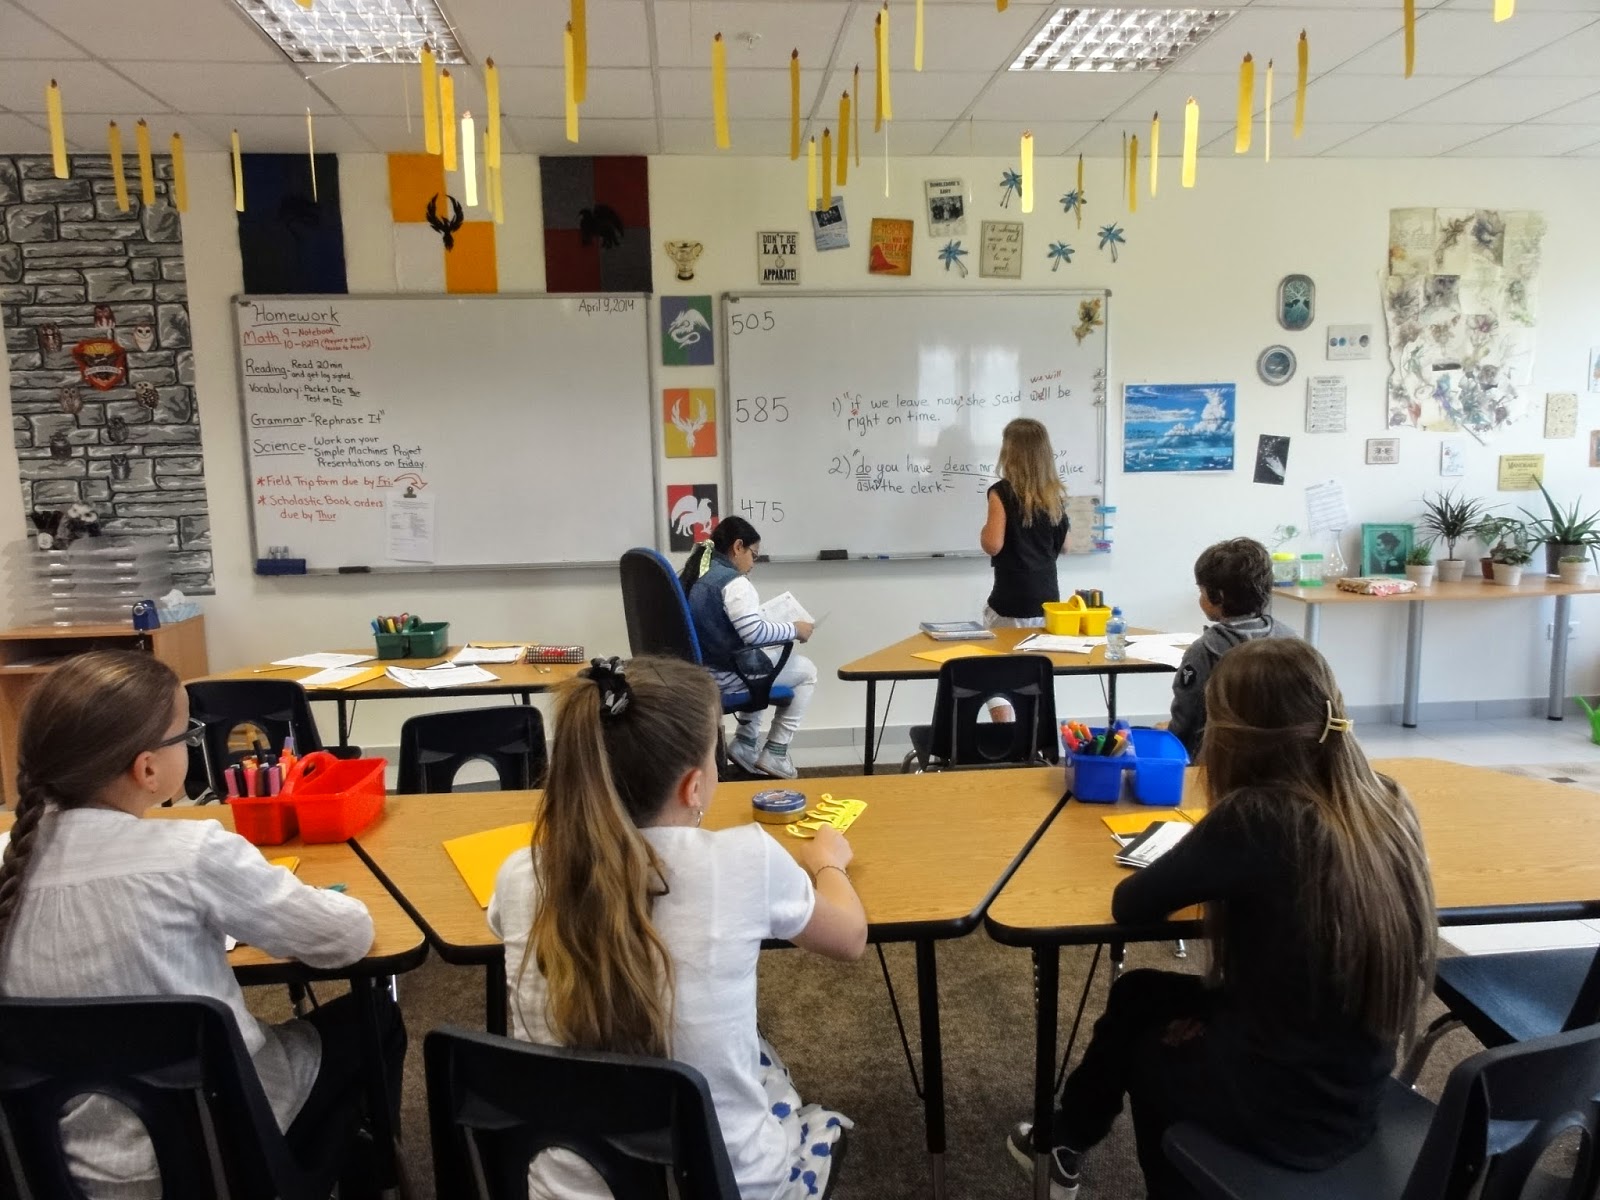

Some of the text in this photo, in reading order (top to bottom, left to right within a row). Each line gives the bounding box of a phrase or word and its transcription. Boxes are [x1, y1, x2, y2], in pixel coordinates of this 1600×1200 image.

[763, 233, 796, 244] DON'T BE
[763, 244, 796, 254] LATE
[763, 269, 797, 281] APPARATE!
[252, 304, 339, 323] Homework
[578, 299, 601, 316] April
[731, 310, 775, 335] 505
[244, 331, 280, 345] Math
[291, 360, 314, 369] Read
[316, 361, 329, 369] 20
[307, 371, 318, 381] get
[304, 384, 329, 393] Packet
[304, 394, 320, 403] Test
[871, 400, 889, 409] we
[896, 393, 928, 407] leave
[966, 393, 986, 407] she
[1058, 385, 1071, 398] be
[735, 396, 789, 423] 585
[847, 413, 879, 436] right
[887, 416, 902, 425] on
[314, 435, 341, 445] Work
[358, 437, 379, 445] your
[314, 444, 422, 459] Simple Machines Project
[317, 457, 381, 468] Presentations
[876, 463, 899, 483] you
[906, 454, 933, 473] have
[943, 456, 973, 472] dear
[1060, 461, 1084, 476] alice
[266, 475, 292, 486] Field
[294, 476, 315, 490] Trip
[315, 475, 339, 486] form
[342, 475, 358, 486] due
[364, 476, 374, 489] by
[881, 481, 905, 494] the
[269, 494, 324, 506] Scholastic
[324, 496, 351, 505] Book
[354, 498, 384, 508] orders
[280, 508, 299, 519] due
[302, 509, 313, 522] by
[741, 499, 785, 523] 475
